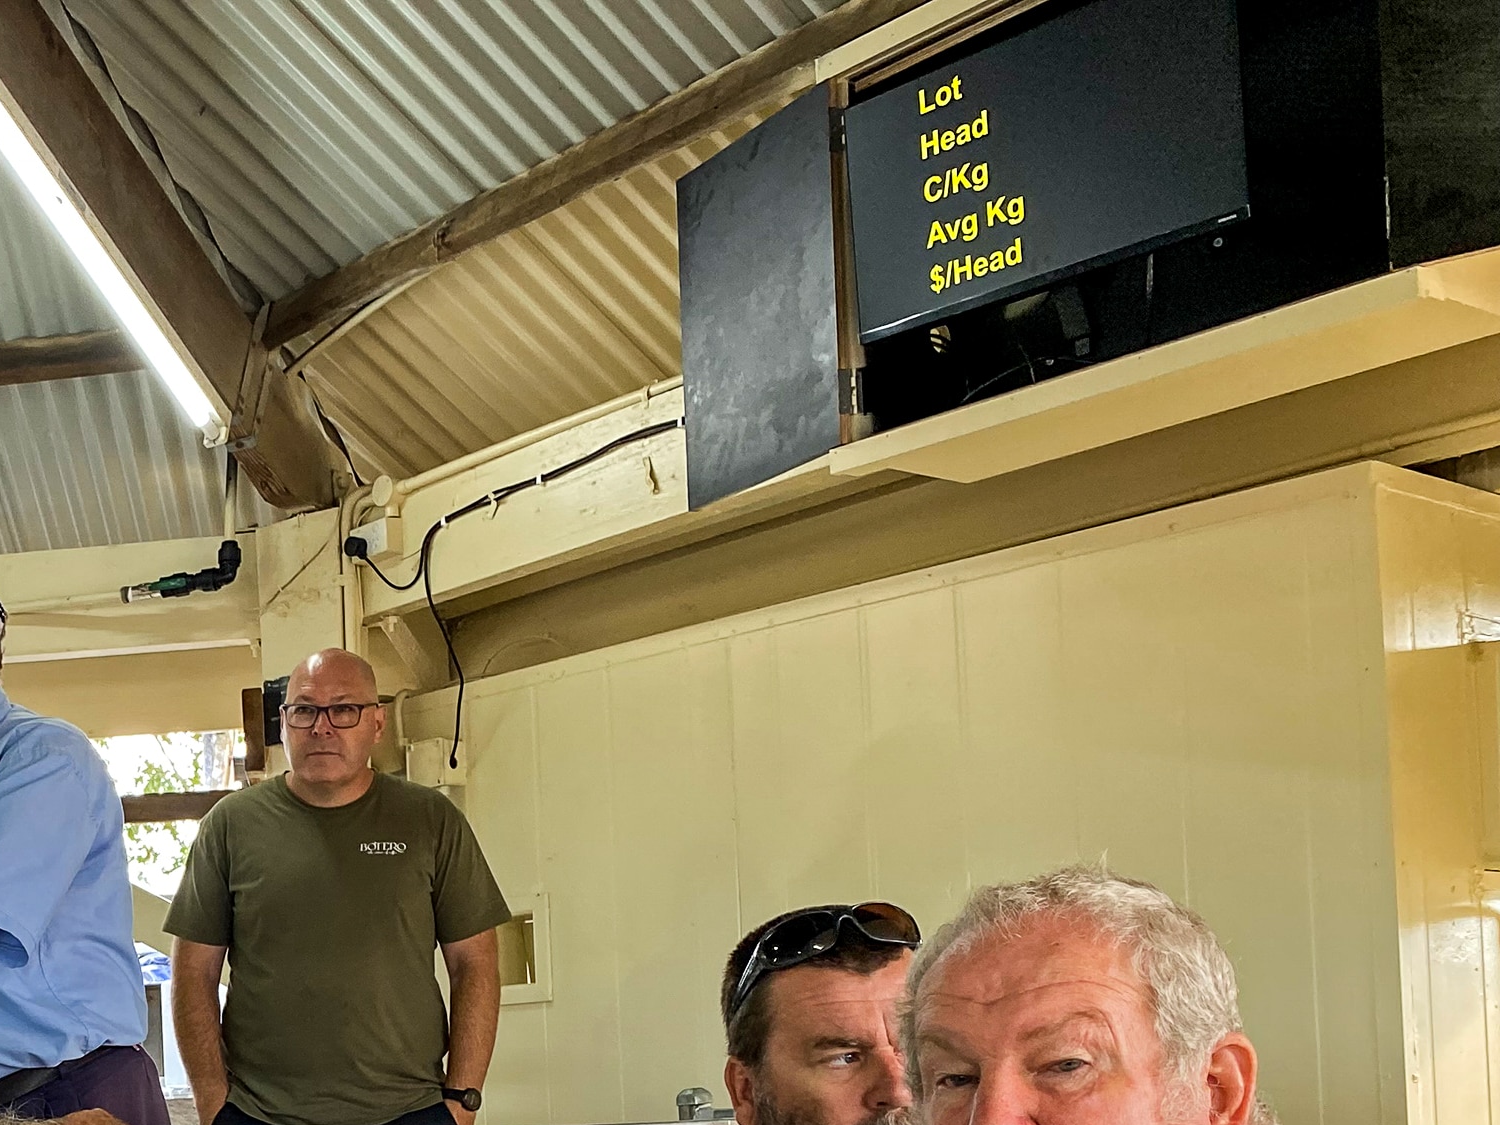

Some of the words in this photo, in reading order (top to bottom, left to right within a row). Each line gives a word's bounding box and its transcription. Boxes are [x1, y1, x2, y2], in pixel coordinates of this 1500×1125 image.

[918, 75, 963, 115] Lot
[920, 110, 989, 159] Head
[923, 161, 989, 203] C/Kg
[926, 210, 979, 250] Avg
[986, 195, 1026, 229] Kg
[929, 237, 1023, 294] $/Head
